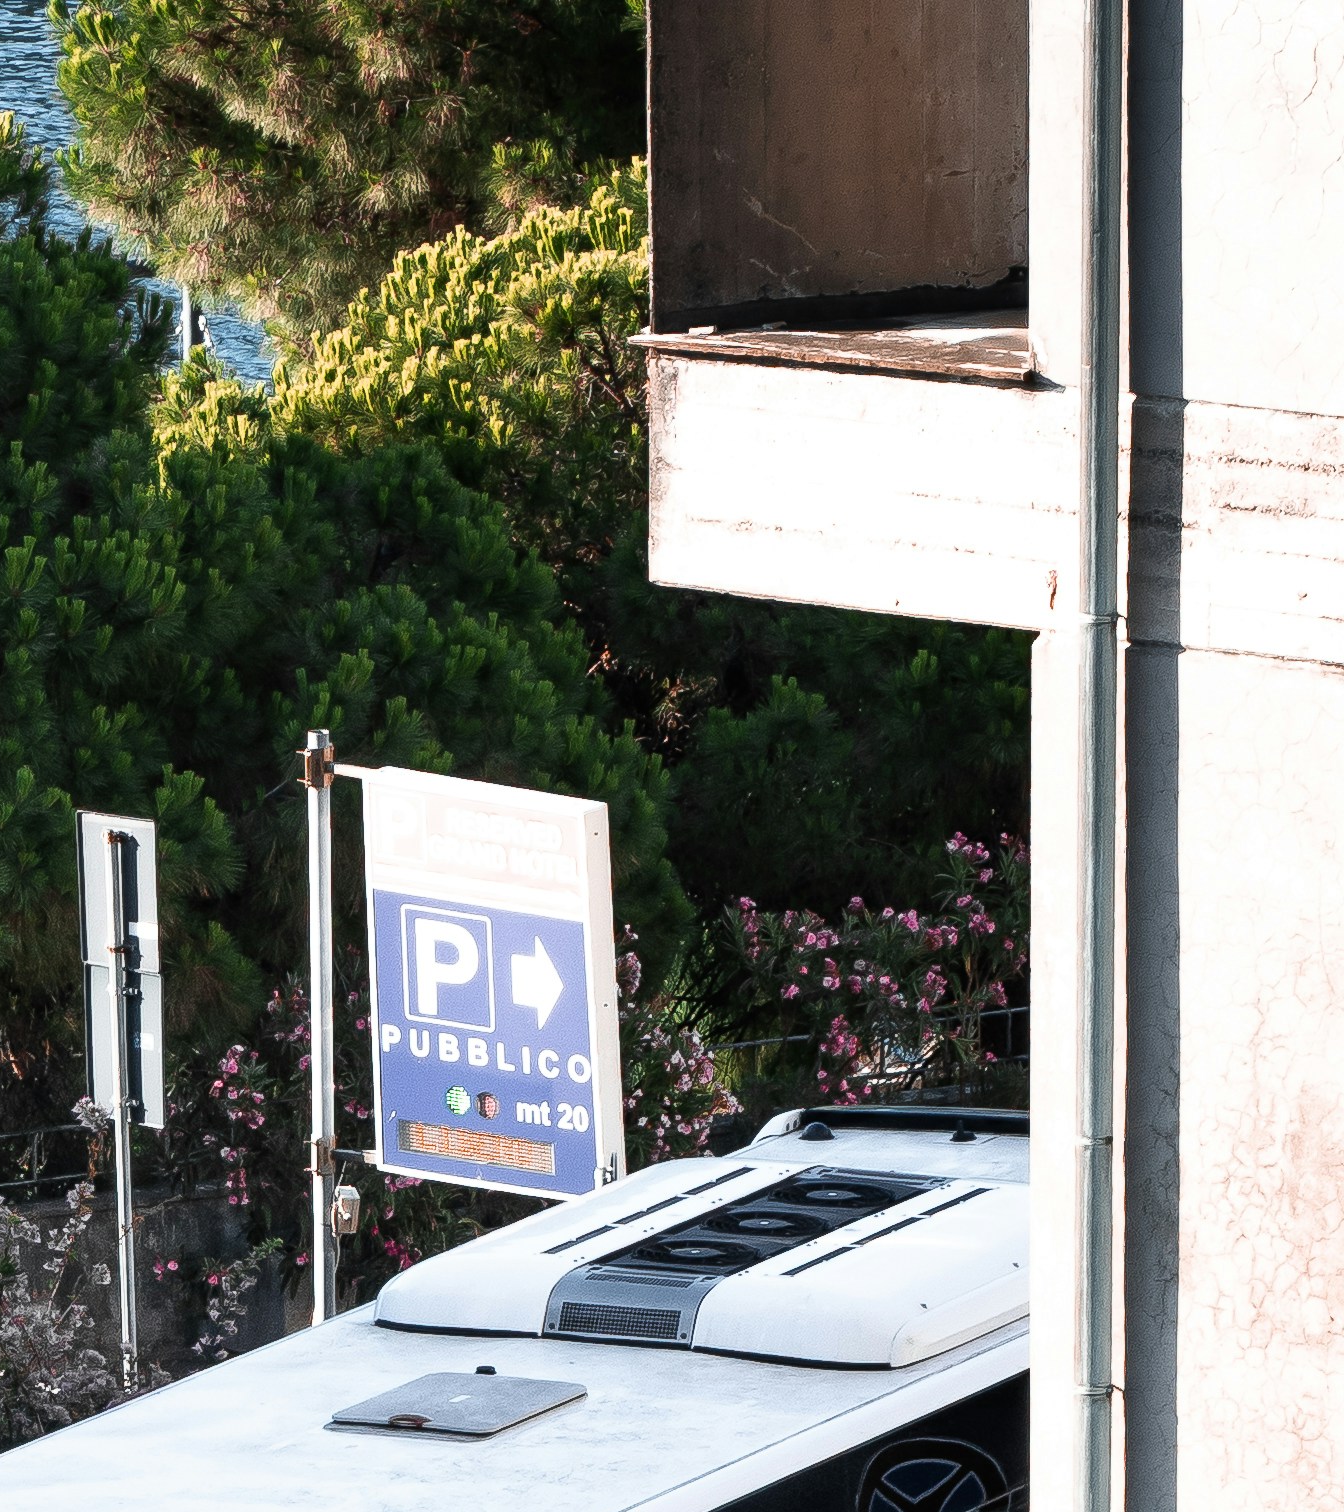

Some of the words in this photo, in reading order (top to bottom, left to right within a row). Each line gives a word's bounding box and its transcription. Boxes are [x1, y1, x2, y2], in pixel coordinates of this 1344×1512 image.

[511, 846, 578, 884] HOTEL
[413, 917, 479, 1016] P
[381, 1023, 592, 1084] PUBBLICO
[515, 1100, 552, 1127] mt
[556, 1102, 590, 1133] 20
